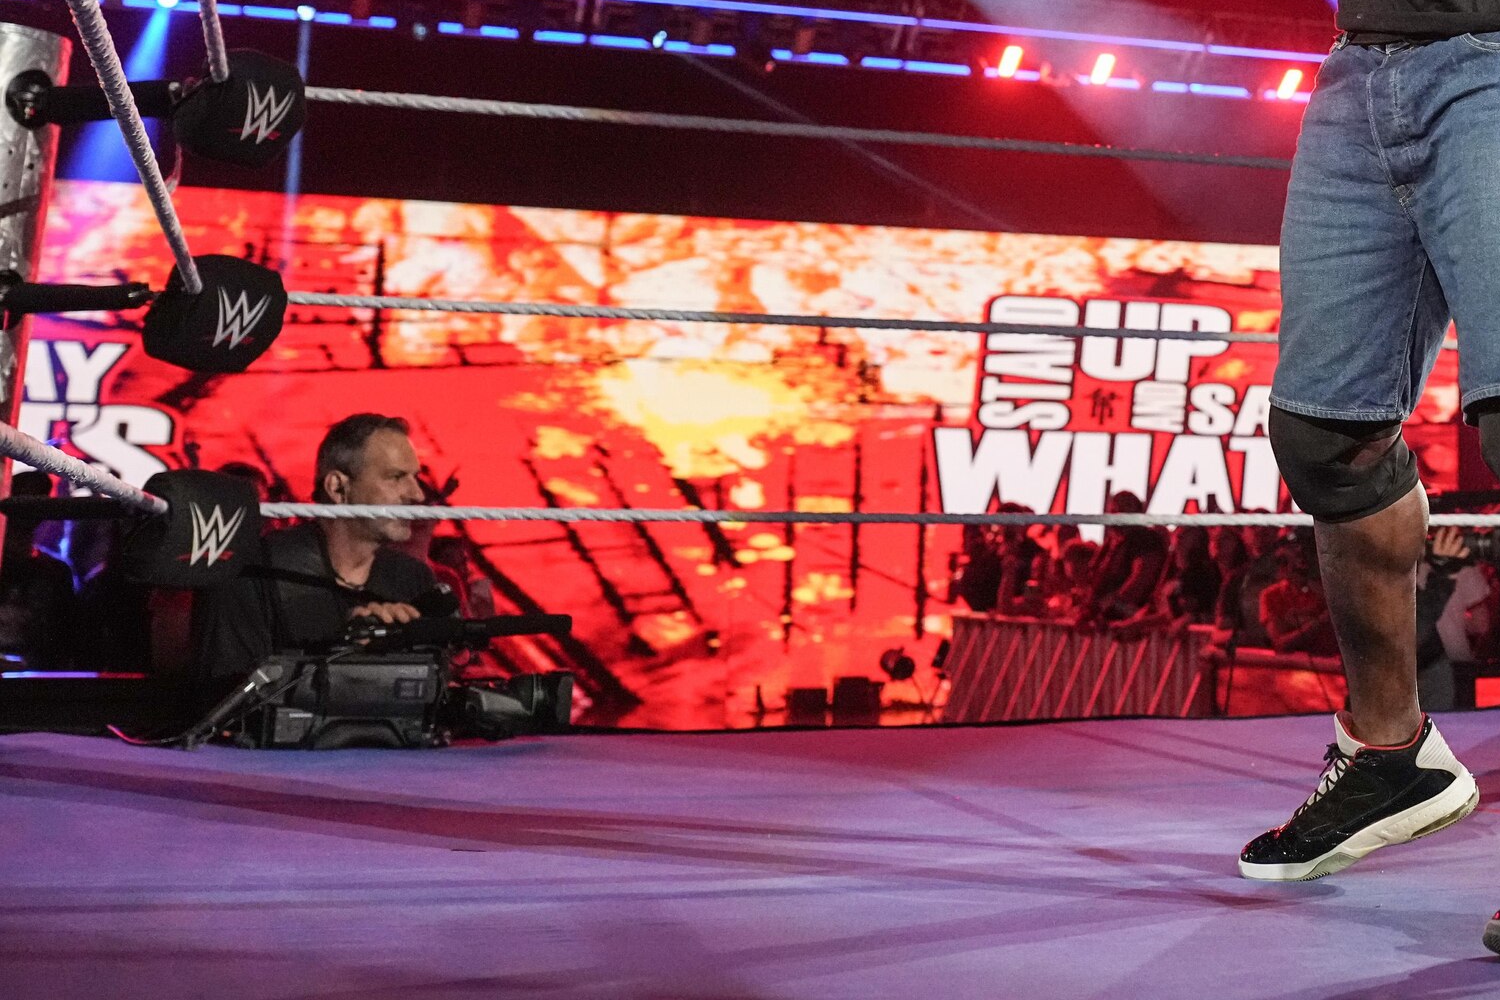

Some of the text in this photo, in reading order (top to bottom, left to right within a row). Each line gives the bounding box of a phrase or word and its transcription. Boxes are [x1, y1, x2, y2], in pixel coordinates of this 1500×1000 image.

[978, 295, 1080, 431] STAND
[1080, 299, 1232, 383] UP
[1131, 380, 1187, 433] AND
[934, 427, 1290, 545] WHAT
